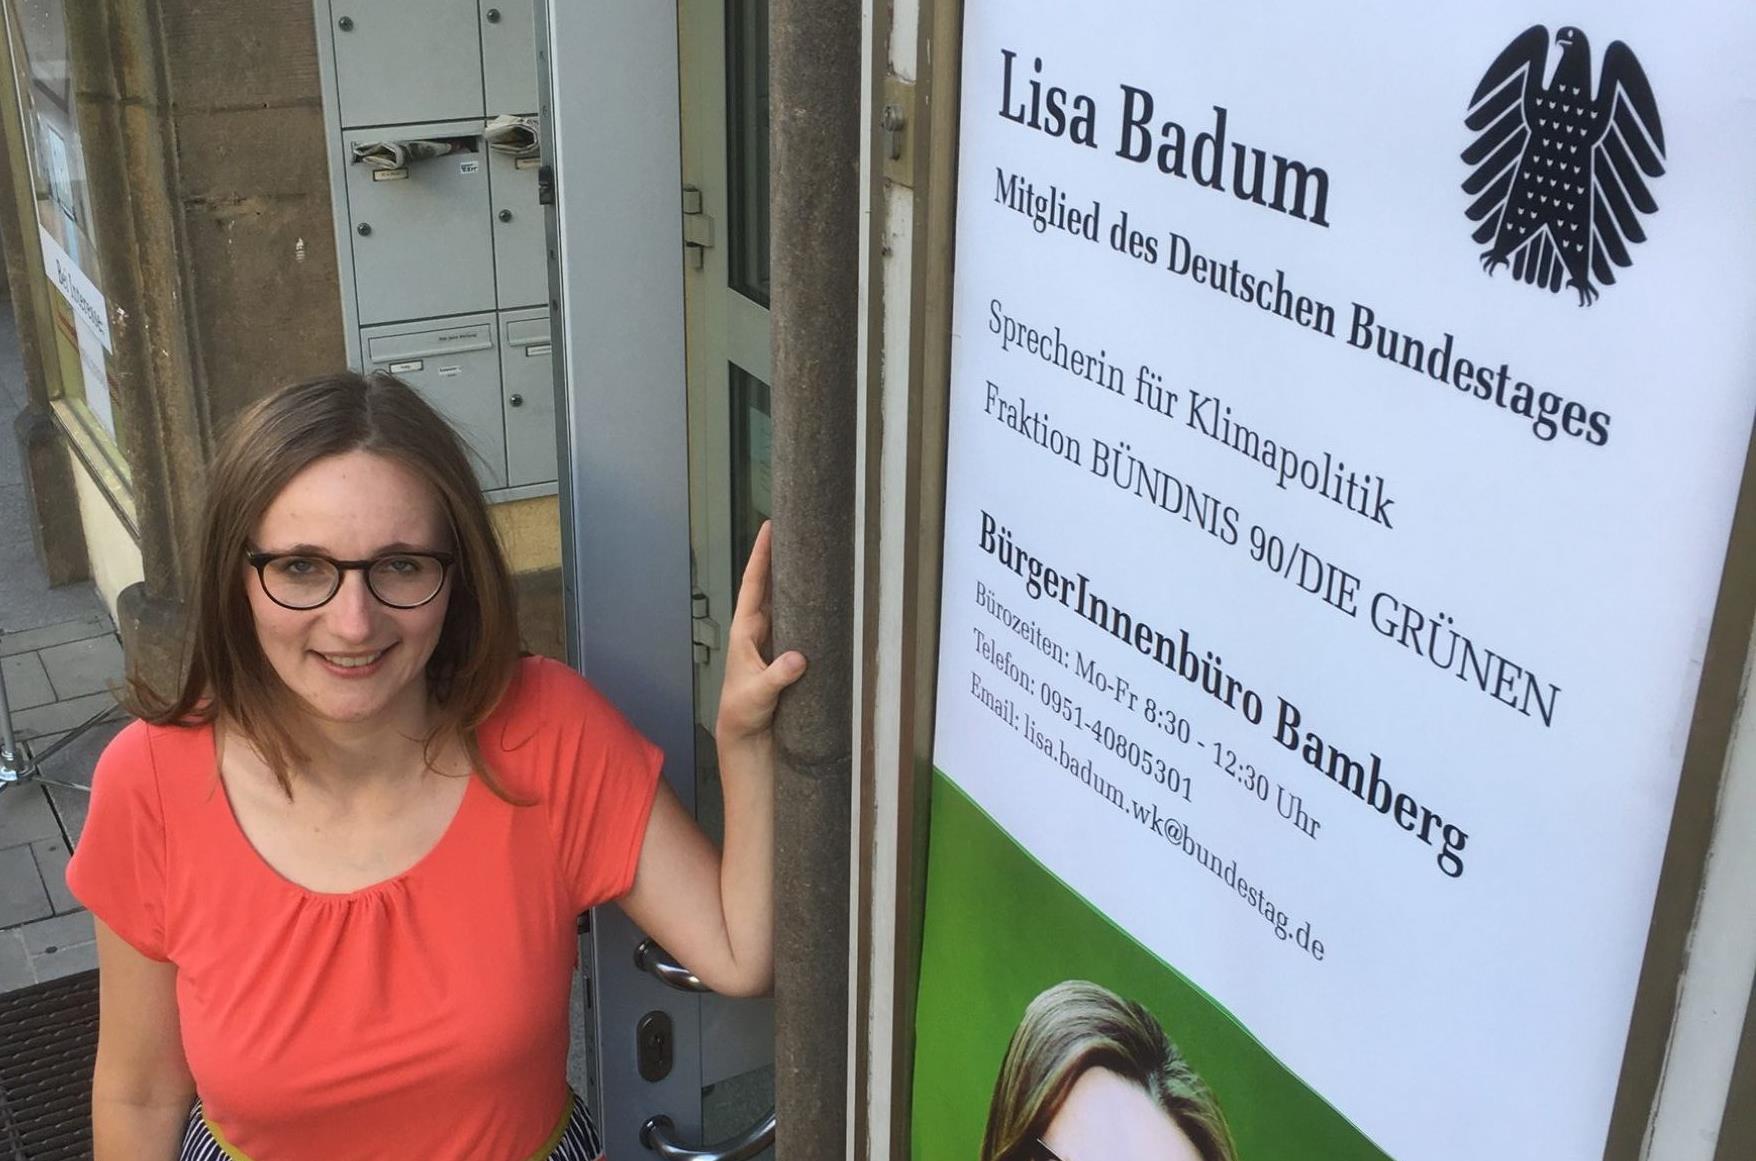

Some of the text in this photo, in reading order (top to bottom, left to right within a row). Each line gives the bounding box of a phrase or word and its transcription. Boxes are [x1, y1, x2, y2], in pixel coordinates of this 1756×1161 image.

[998, 48, 1330, 229] Lisa Badum
[988, 298, 1395, 530] Sprecherin für Klimapolitik
[994, 166, 1612, 447] Mitglied des Deutschen Bundestages
[983, 379, 1562, 728] Fraktion BÜNDNIS 90/DIE GRÜNEN
[970, 671, 1325, 962] Email: lisa.badum.wk@bundestag.de
[973, 627, 1192, 803] Telefon: 0951-40805301
[975, 580, 1069, 669] Bürozeiten:
[1074, 651, 1139, 712] Mo-Fr
[1143, 697, 1191, 744] 8:30
[1213, 742, 1270, 802] 12:30
[1276, 784, 1321, 840] Uhr
[978, 509, 1470, 879] BürgerInnenbüro Bamberg
